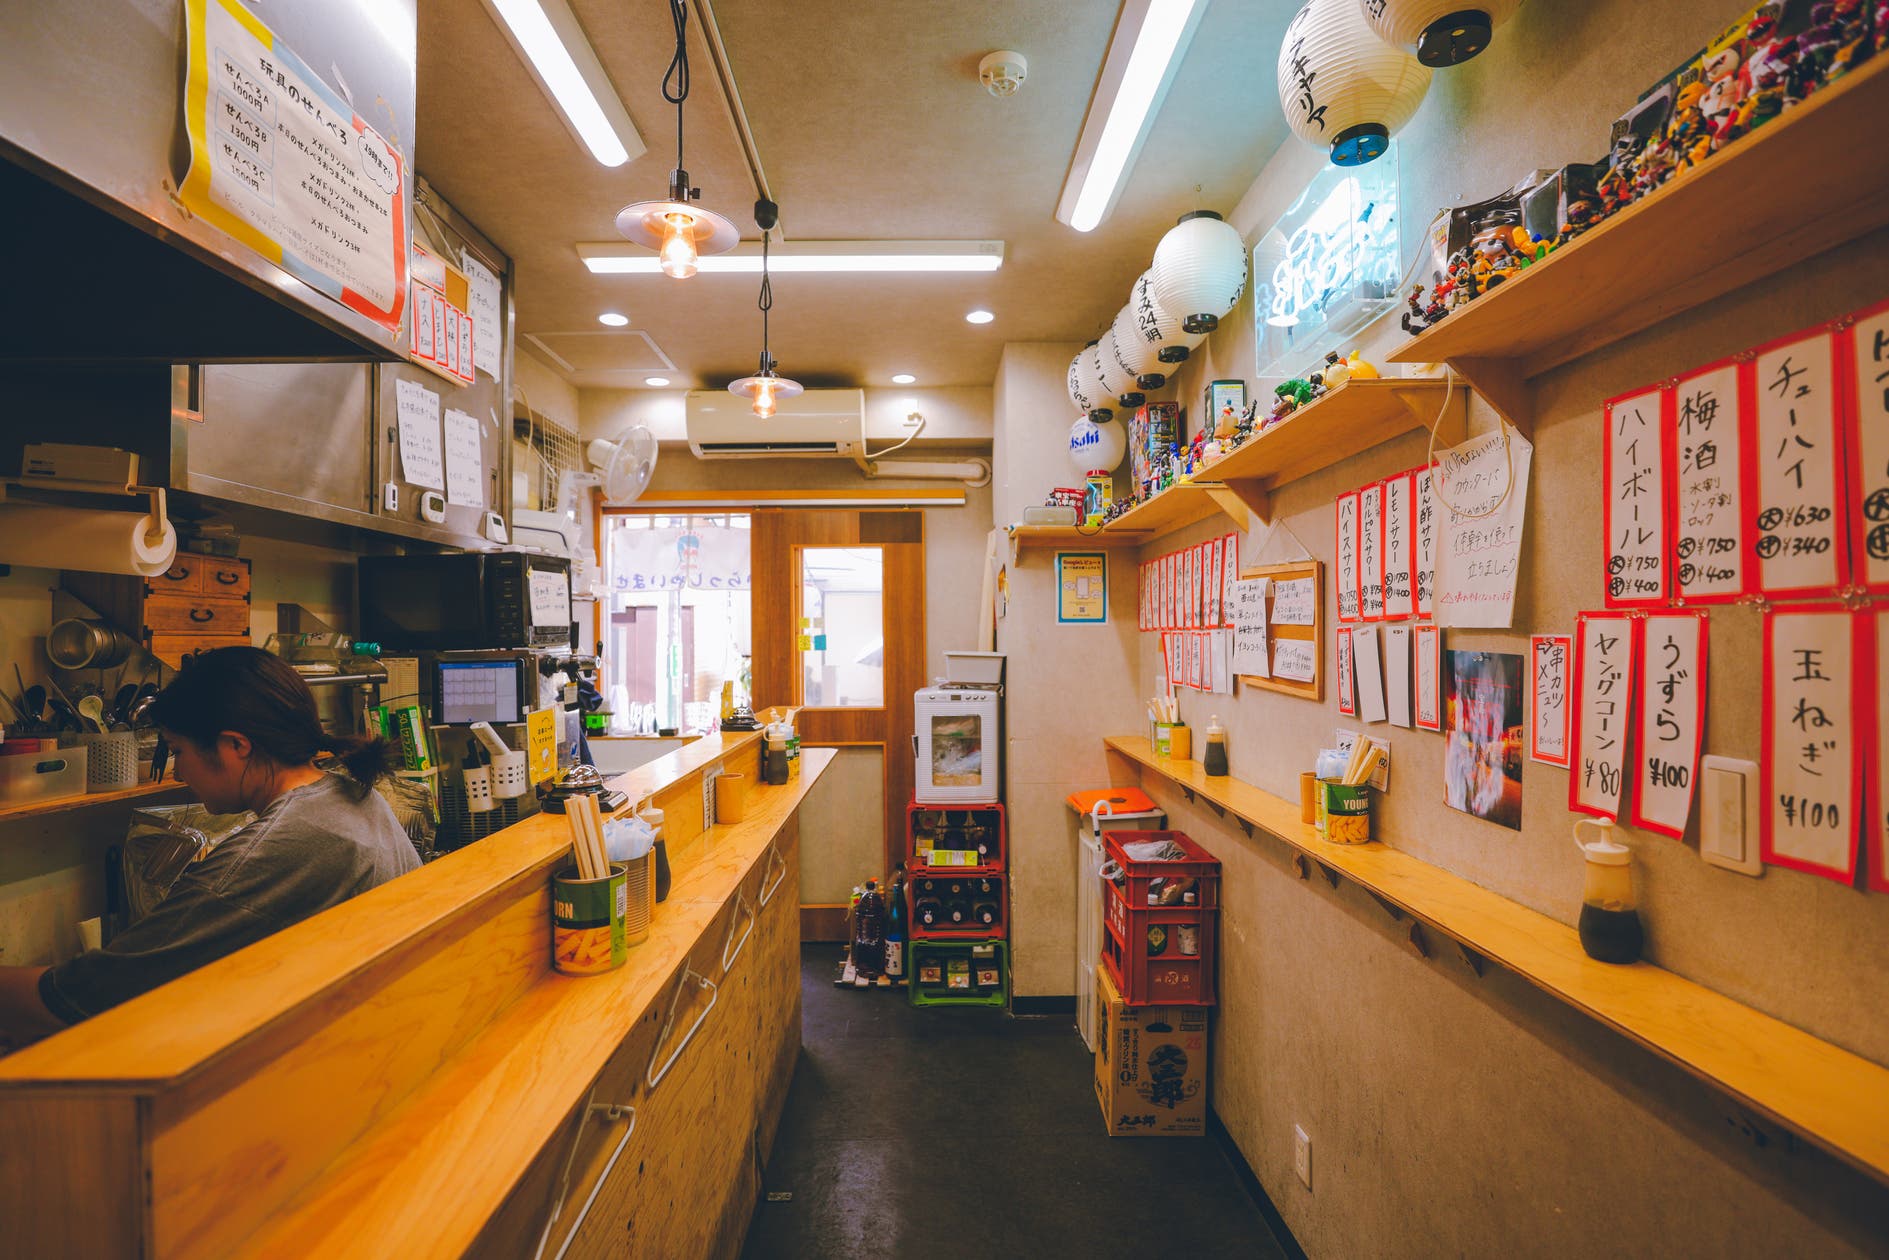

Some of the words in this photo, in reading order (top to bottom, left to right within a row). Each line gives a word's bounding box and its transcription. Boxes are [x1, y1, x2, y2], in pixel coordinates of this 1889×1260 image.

[230, 125, 259, 152] 1300円
[232, 82, 263, 112] 1000円
[260, 58, 347, 145] 玩具のせんべろ
[1678, 391, 1720, 475] 梅酒
[1769, 357, 1814, 488] チューハイ
[1620, 409, 1653, 549] ハイボール
[1341, 501, 1353, 589] バイスサワー
[1364, 493, 1373, 576] カルピスサワー
[1390, 483, 1400, 563] レモンサワー
[1550, 646, 1563, 709] 串カツ
[1594, 633, 1622, 750] ヤングコーン
[1656, 635, 1688, 741] うずら
[1792, 649, 1836, 776] 玉ねぎ
[1585, 758, 1619, 797] ¥80
[1649, 758, 1689, 788] ¥100
[1780, 794, 1839, 829] ¥100
